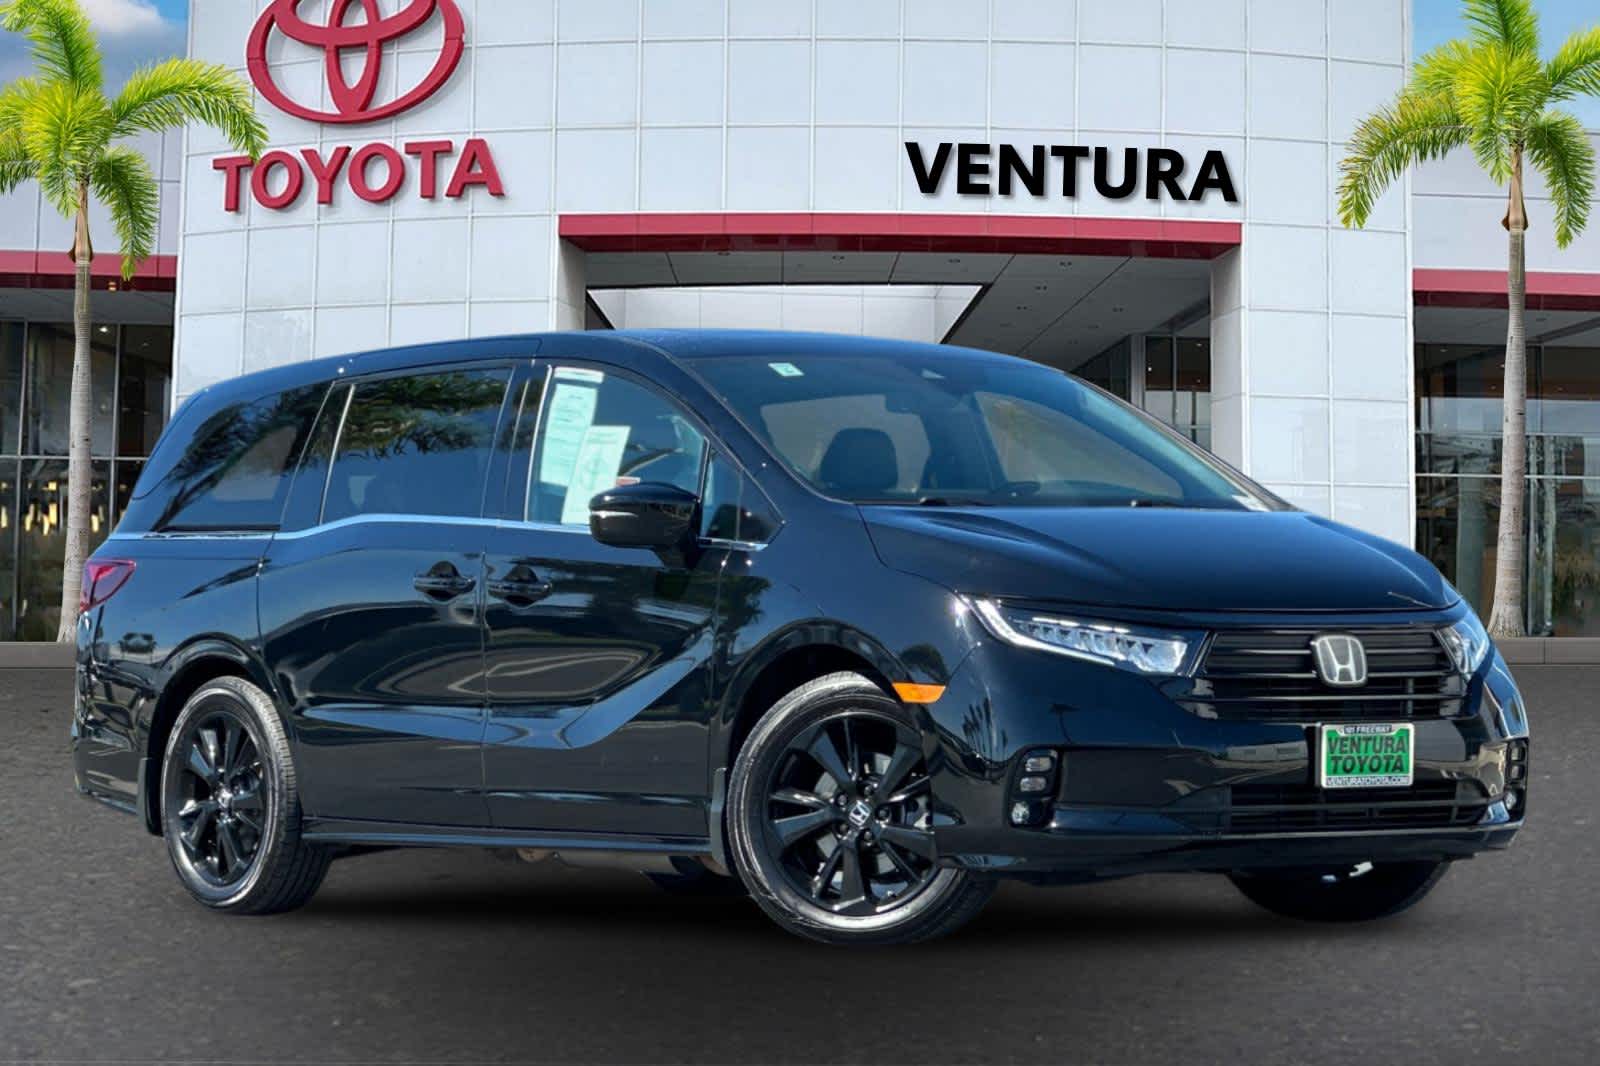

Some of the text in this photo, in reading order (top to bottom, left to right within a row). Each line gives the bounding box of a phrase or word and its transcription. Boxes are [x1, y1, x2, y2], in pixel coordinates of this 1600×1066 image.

[212, 138, 505, 213] TOYOTA
[904, 142, 1239, 203] VENTURA
[1327, 736, 1406, 754] VENTURA
[1331, 755, 1404, 774] TOYOTA
